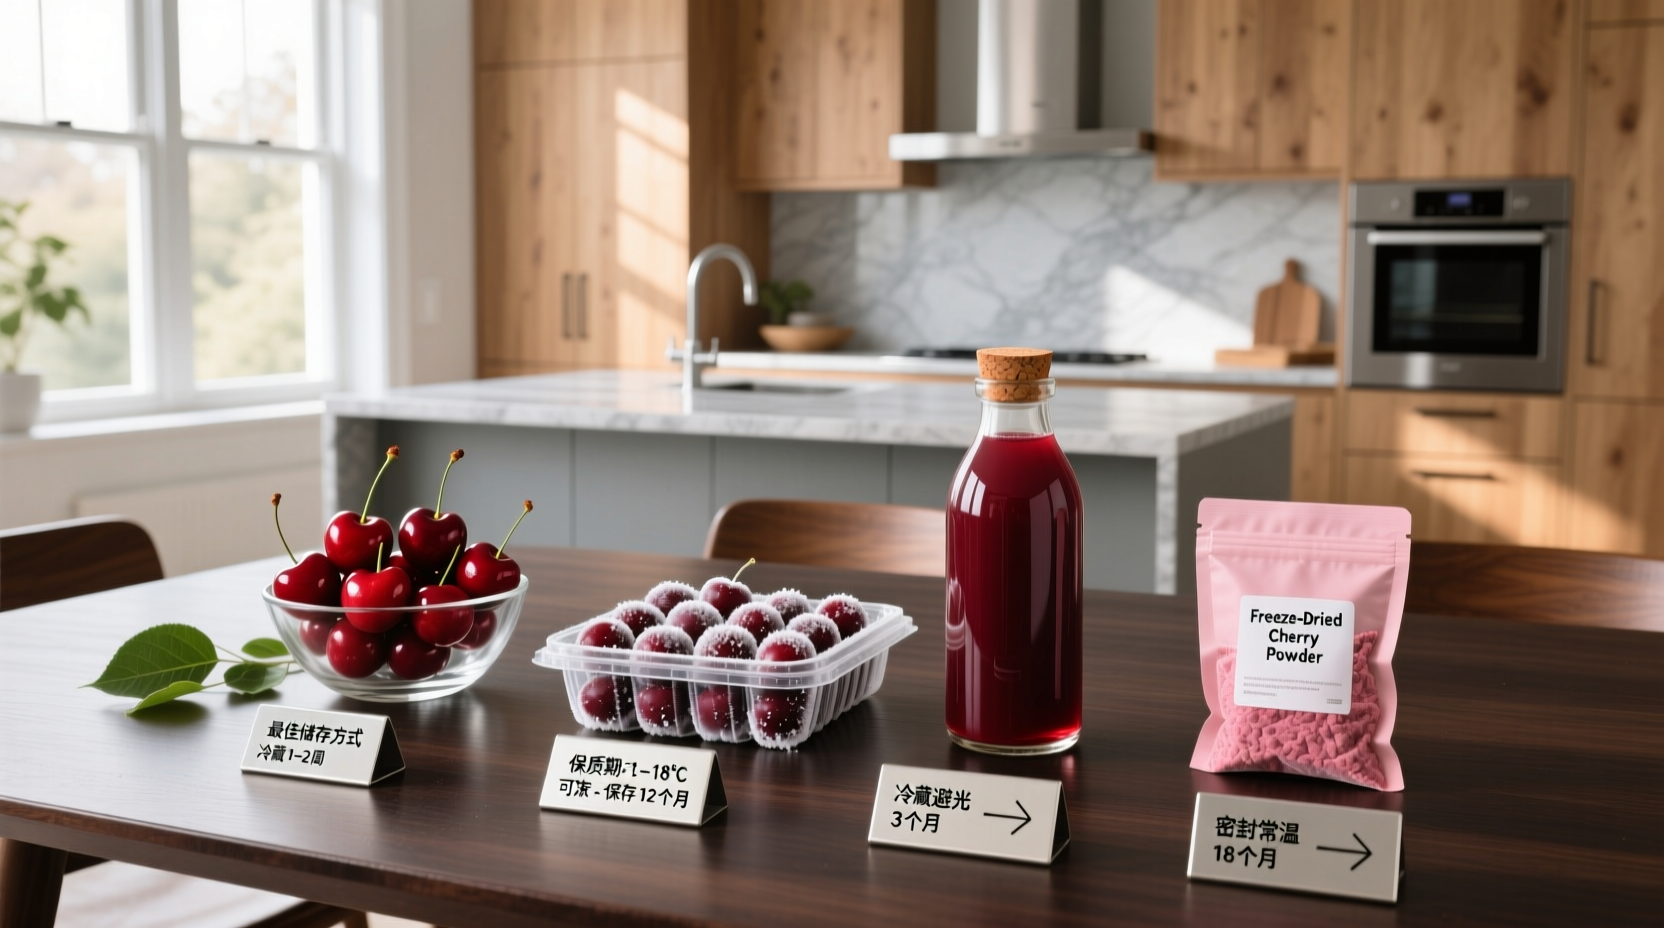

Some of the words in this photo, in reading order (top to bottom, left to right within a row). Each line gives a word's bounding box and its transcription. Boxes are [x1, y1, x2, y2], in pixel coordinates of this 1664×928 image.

[1250, 608, 1343, 627] Freeze-Dried
[1268, 628, 1319, 649] Cherry
[1266, 646, 1323, 664] Powder
[894, 783, 971, 811] 冷藏避光
[890, 811, 941, 833] 3个月
[1214, 815, 1300, 845] 密封常温
[1213, 845, 1277, 869] 18个月
